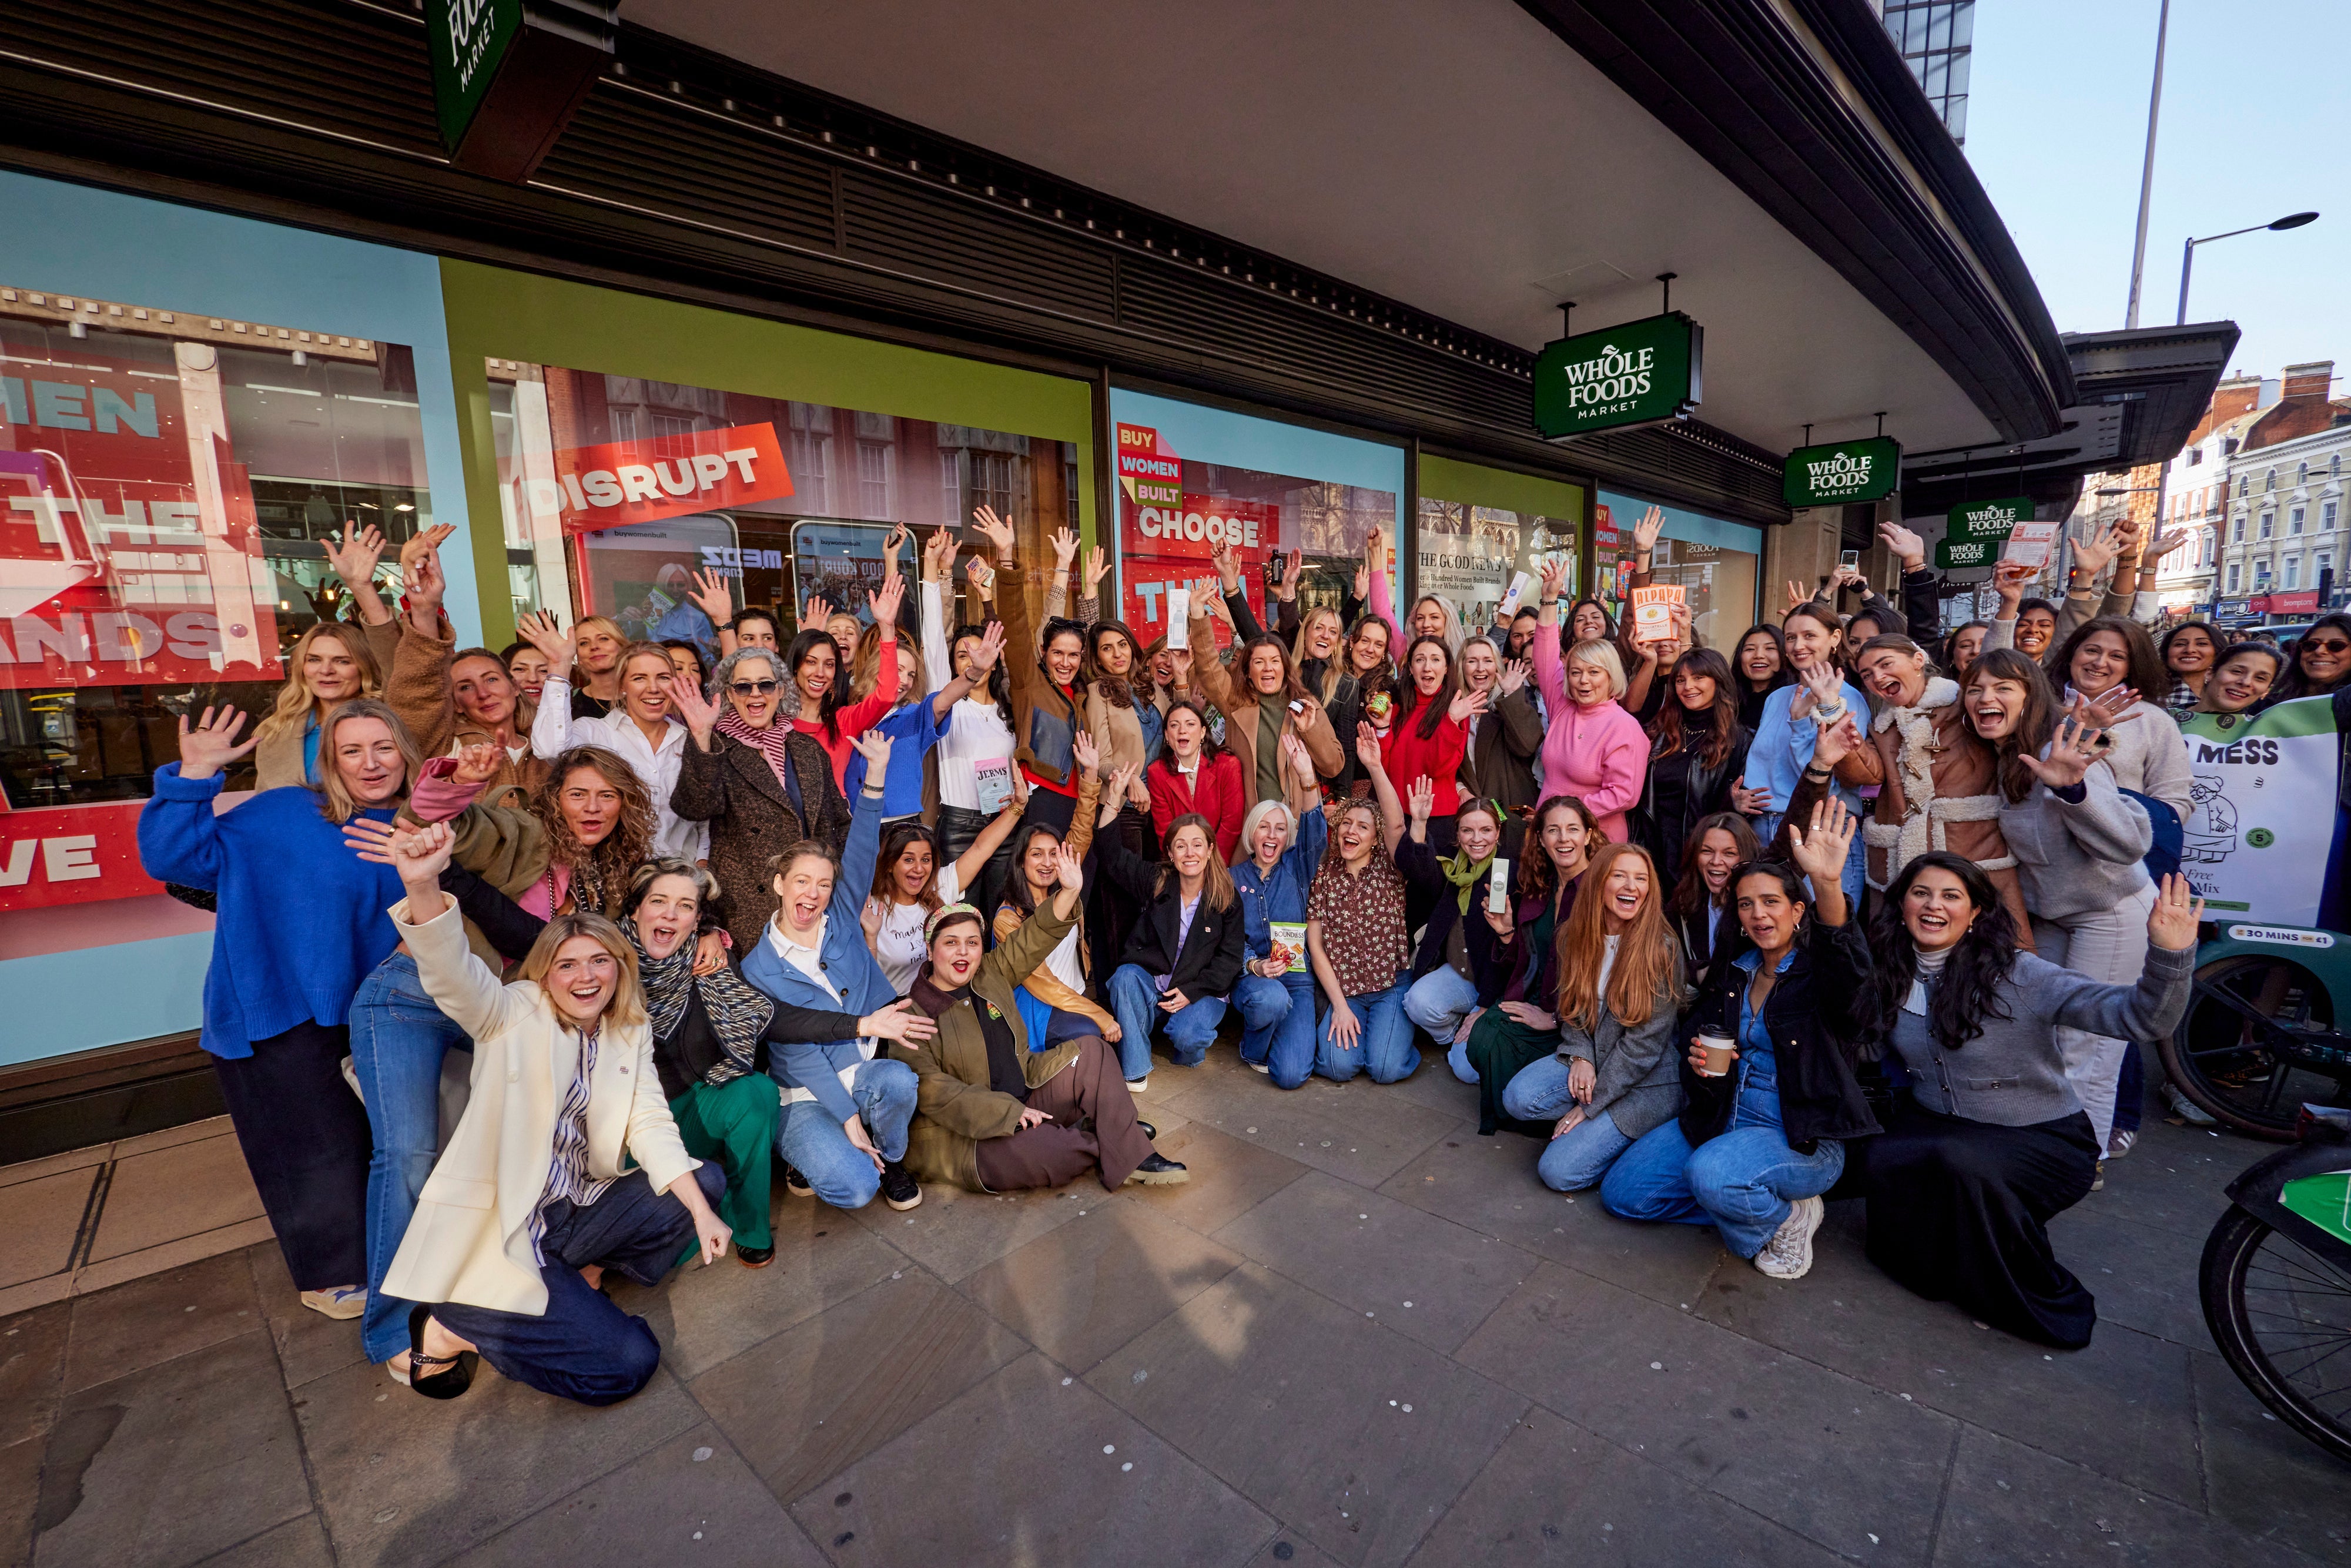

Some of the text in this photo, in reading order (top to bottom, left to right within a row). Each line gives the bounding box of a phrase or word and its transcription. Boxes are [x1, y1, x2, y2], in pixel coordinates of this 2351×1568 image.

[461, 6, 494, 93] MARKET
[1564, 346, 1653, 385] WHOLE
[1569, 371, 1651, 408] FOODS
[1578, 400, 1637, 419] MARKET
[1120, 429, 1153, 447] BUY
[1121, 455, 1178, 477] WOMEN
[1807, 453, 1872, 476] WHOLE
[521, 447, 758, 517] DISRUPT
[1809, 470, 1869, 490] FOODS
[1138, 484, 1179, 502] BUILT
[1816, 488, 1859, 497] MARKET
[9, 495, 205, 546] THE
[1966, 505, 2016, 522] WHOLE
[1138, 507, 1258, 548] CHOOSE
[1968, 518, 2014, 531] FOODS
[614, 531, 667, 539] buywomenbuilt
[820, 539, 861, 547] buywomenbuilt
[1949, 544, 1985, 553] WHOLE
[1950, 551, 1984, 560] FOODS
[1472, 557, 1501, 572] NEWS
[1598, 551, 1616, 564] BUILT
[1431, 574, 1453, 582] Hundred
[1636, 588, 1666, 605] ALPA
[2283, 599, 2313, 608] bromptons
[0, 611, 229, 664] NDS
[2196, 739, 2279, 765] MESS
[977, 768, 1007, 780] JERMS
[2256, 834, 2263, 842] 5
[2186, 869, 2213, 880] Free
[2196, 883, 2220, 893] Mix
[2265, 932, 2299, 941] MINS
